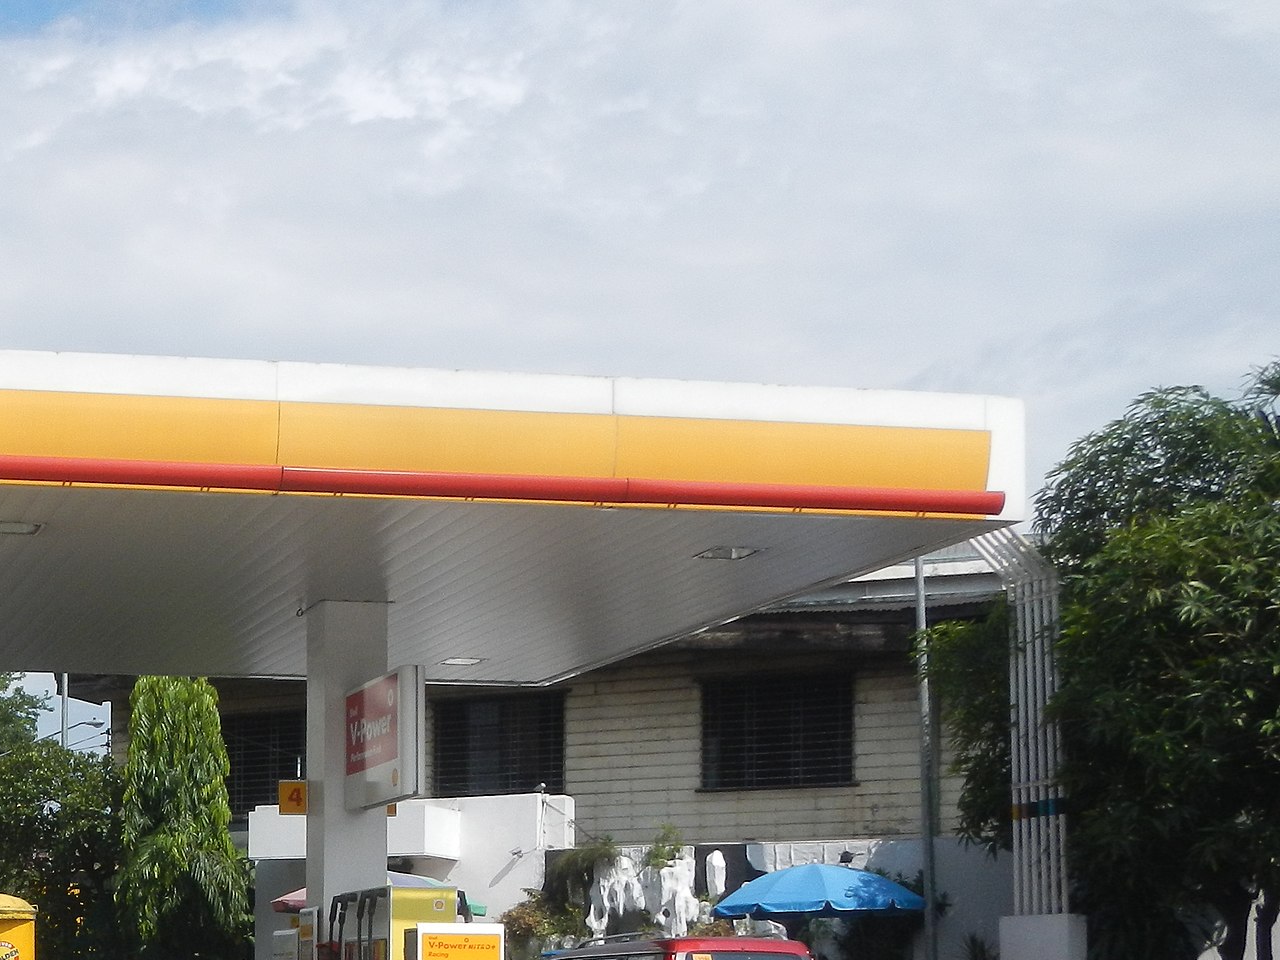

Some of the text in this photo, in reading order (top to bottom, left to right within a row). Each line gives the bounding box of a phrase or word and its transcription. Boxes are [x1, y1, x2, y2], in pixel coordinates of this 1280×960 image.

[350, 713, 392, 746] V-Power
[287, 788, 303, 807] 4
[428, 941, 466, 949] V-Power
